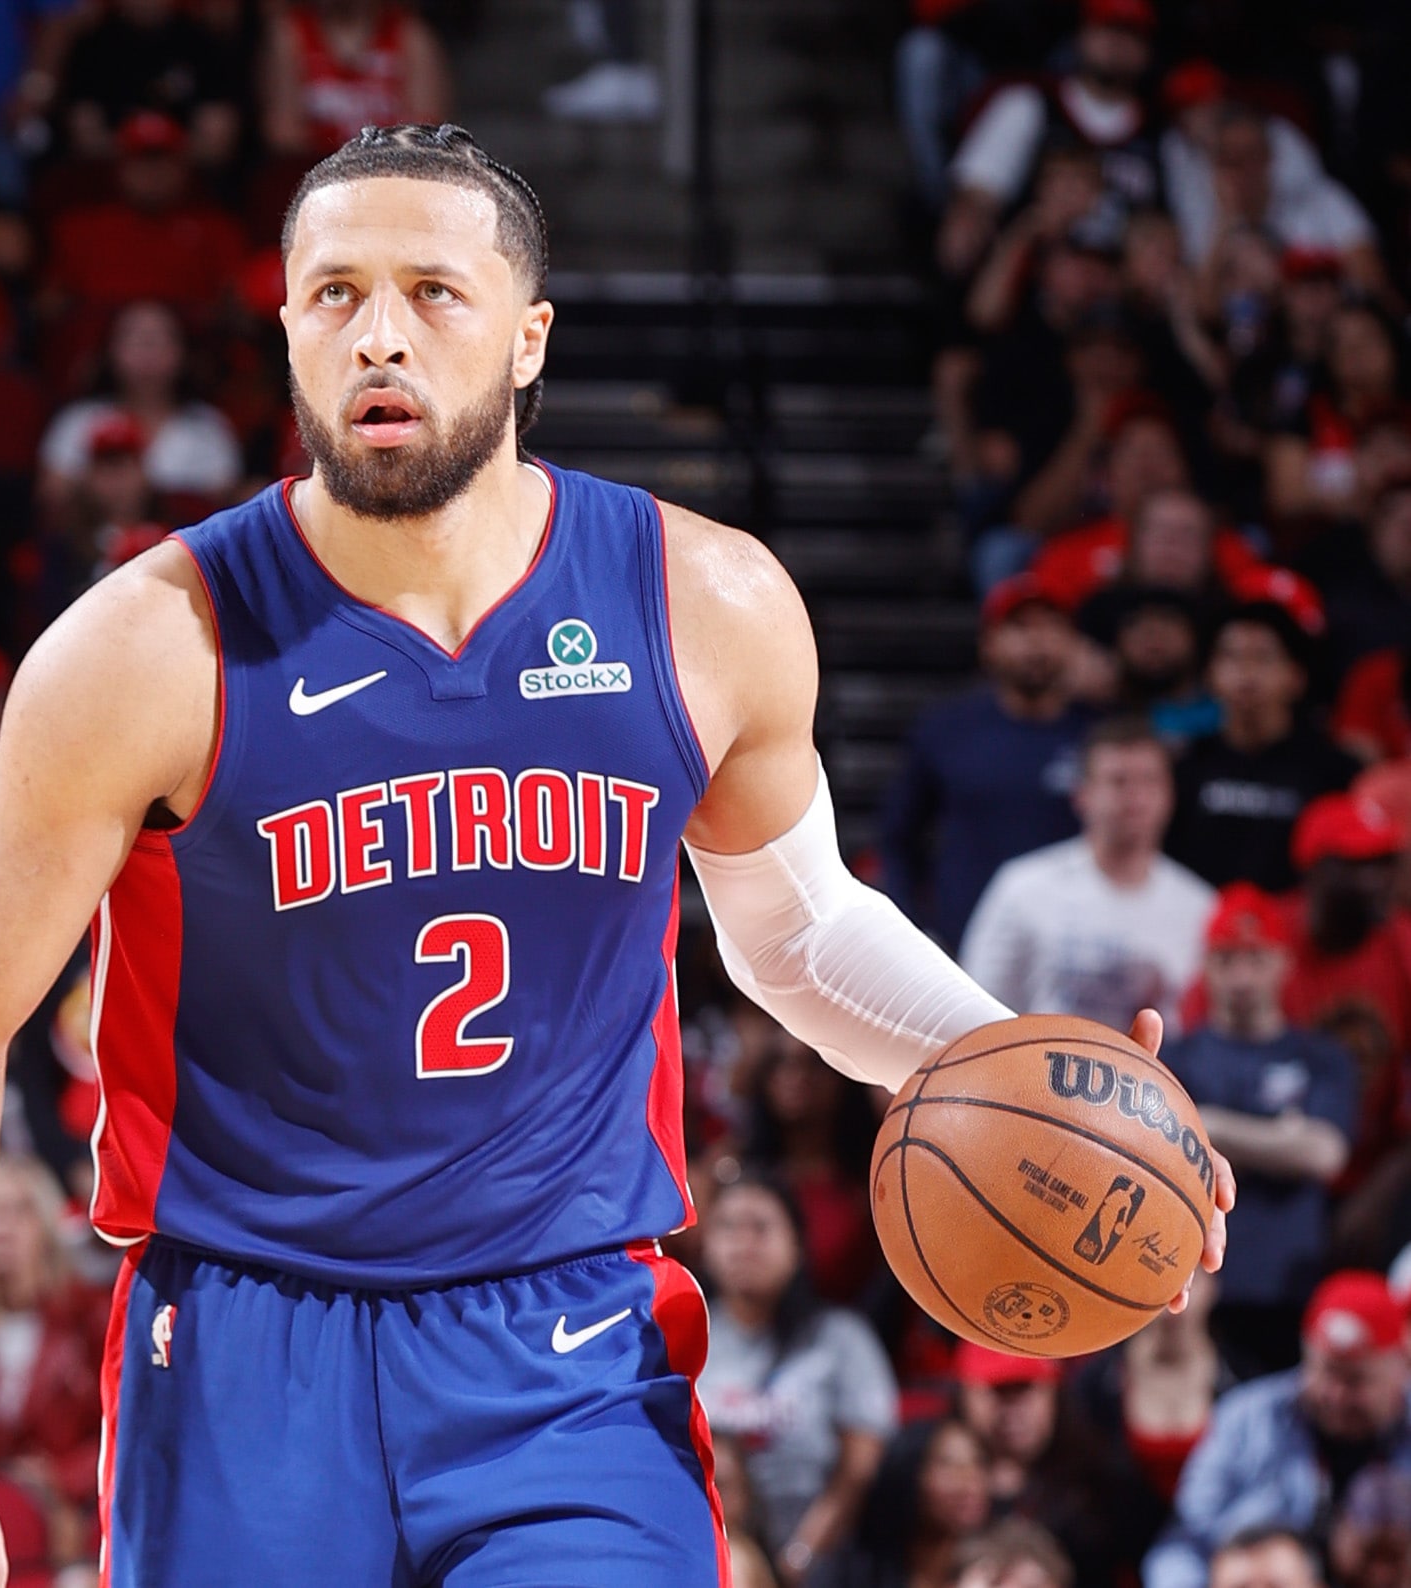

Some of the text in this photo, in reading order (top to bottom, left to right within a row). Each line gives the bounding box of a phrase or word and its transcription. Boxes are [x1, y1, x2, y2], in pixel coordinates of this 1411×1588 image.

[525, 668, 627, 693] StockX
[257, 767, 659, 912] DETROIT
[414, 913, 514, 1080] 2
[1018, 1158, 1089, 1210] OFFICIAL GAME BALL
[1045, 1051, 1214, 1202] Wilson
